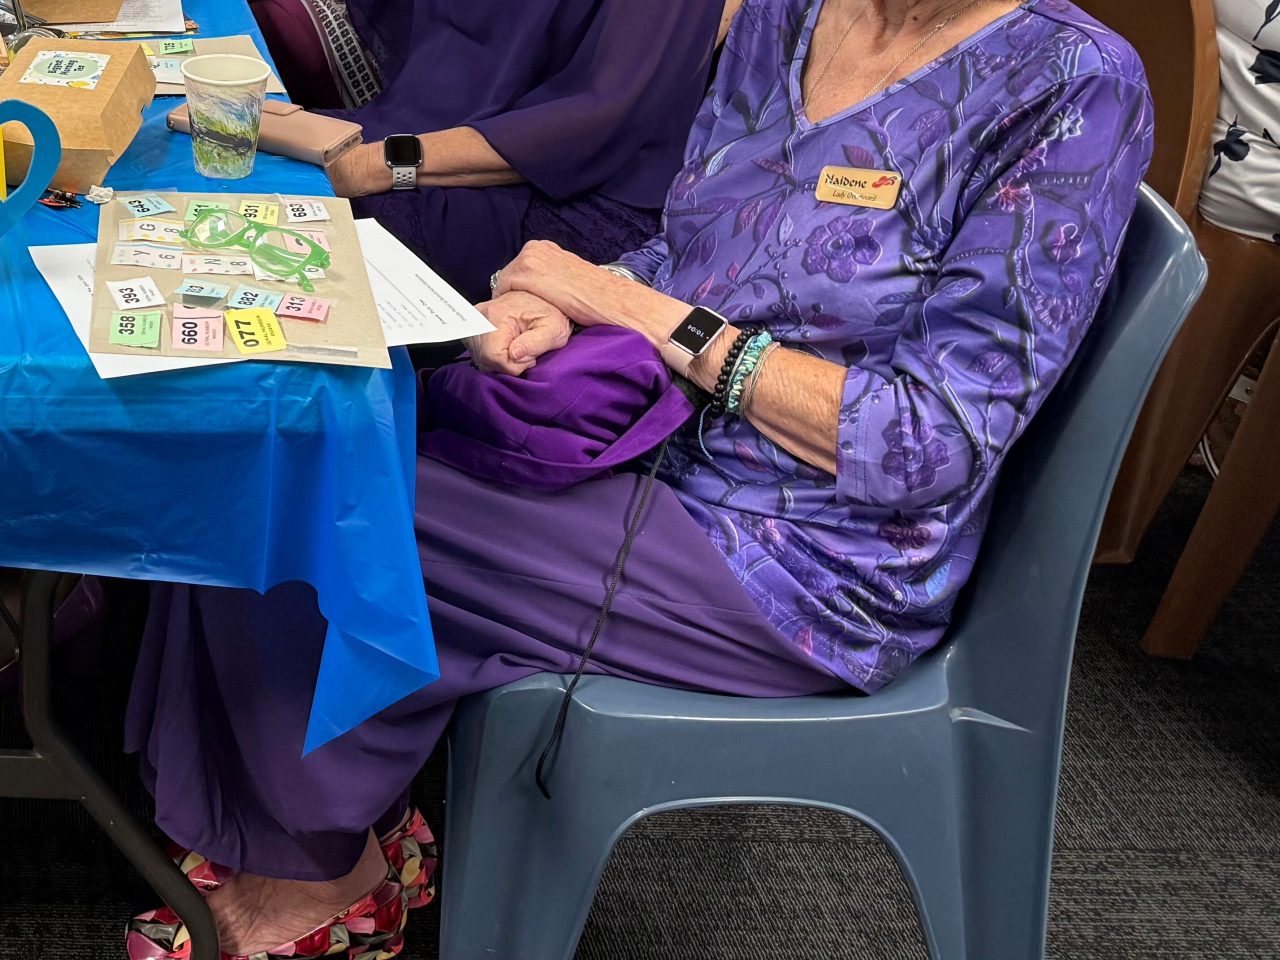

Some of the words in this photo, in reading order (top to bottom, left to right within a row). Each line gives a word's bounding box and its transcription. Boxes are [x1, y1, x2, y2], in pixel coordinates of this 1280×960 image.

[825, 173, 868, 189] Naidene
[128, 199, 151, 213] 643
[243, 204, 260, 218] 931
[289, 203, 307, 218] 683
[140, 223, 156, 232] G
[204, 258, 221, 266] N
[118, 287, 141, 304] 393
[285, 296, 306, 312] 313
[118, 316, 136, 335] 358
[181, 321, 198, 345] 660
[234, 319, 260, 348] 077
